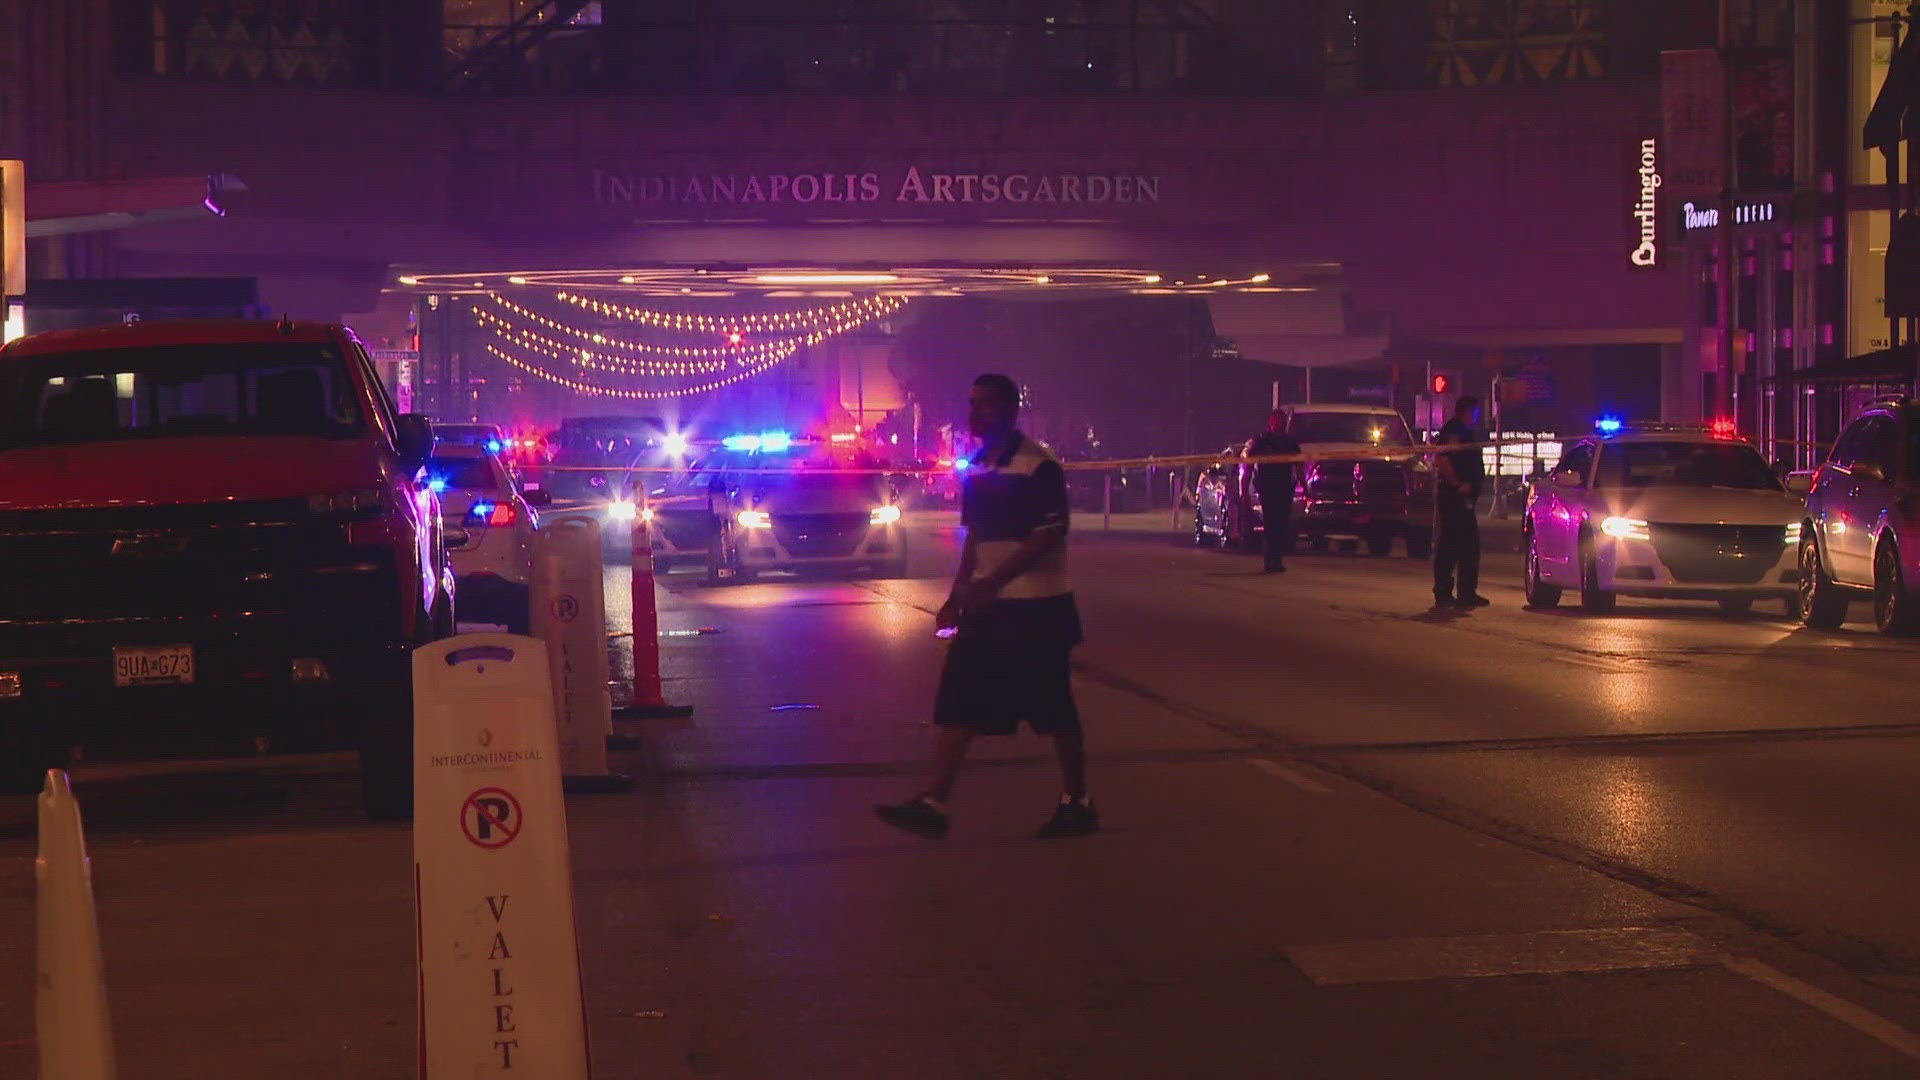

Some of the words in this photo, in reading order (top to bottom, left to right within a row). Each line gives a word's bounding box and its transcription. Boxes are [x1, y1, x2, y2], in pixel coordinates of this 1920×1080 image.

[593, 168, 880, 202] INDIANAPOLIS
[896, 165, 1160, 202] ARTSGARDEN
[1631, 137, 1662, 266] Burlington
[1736, 202, 1773, 225] BREAD
[118, 655, 150, 677] 9UA
[158, 653, 190, 675] G73
[431, 751, 543, 768] INTERCONTINENTAL
[485, 895, 519, 1070] VALET
